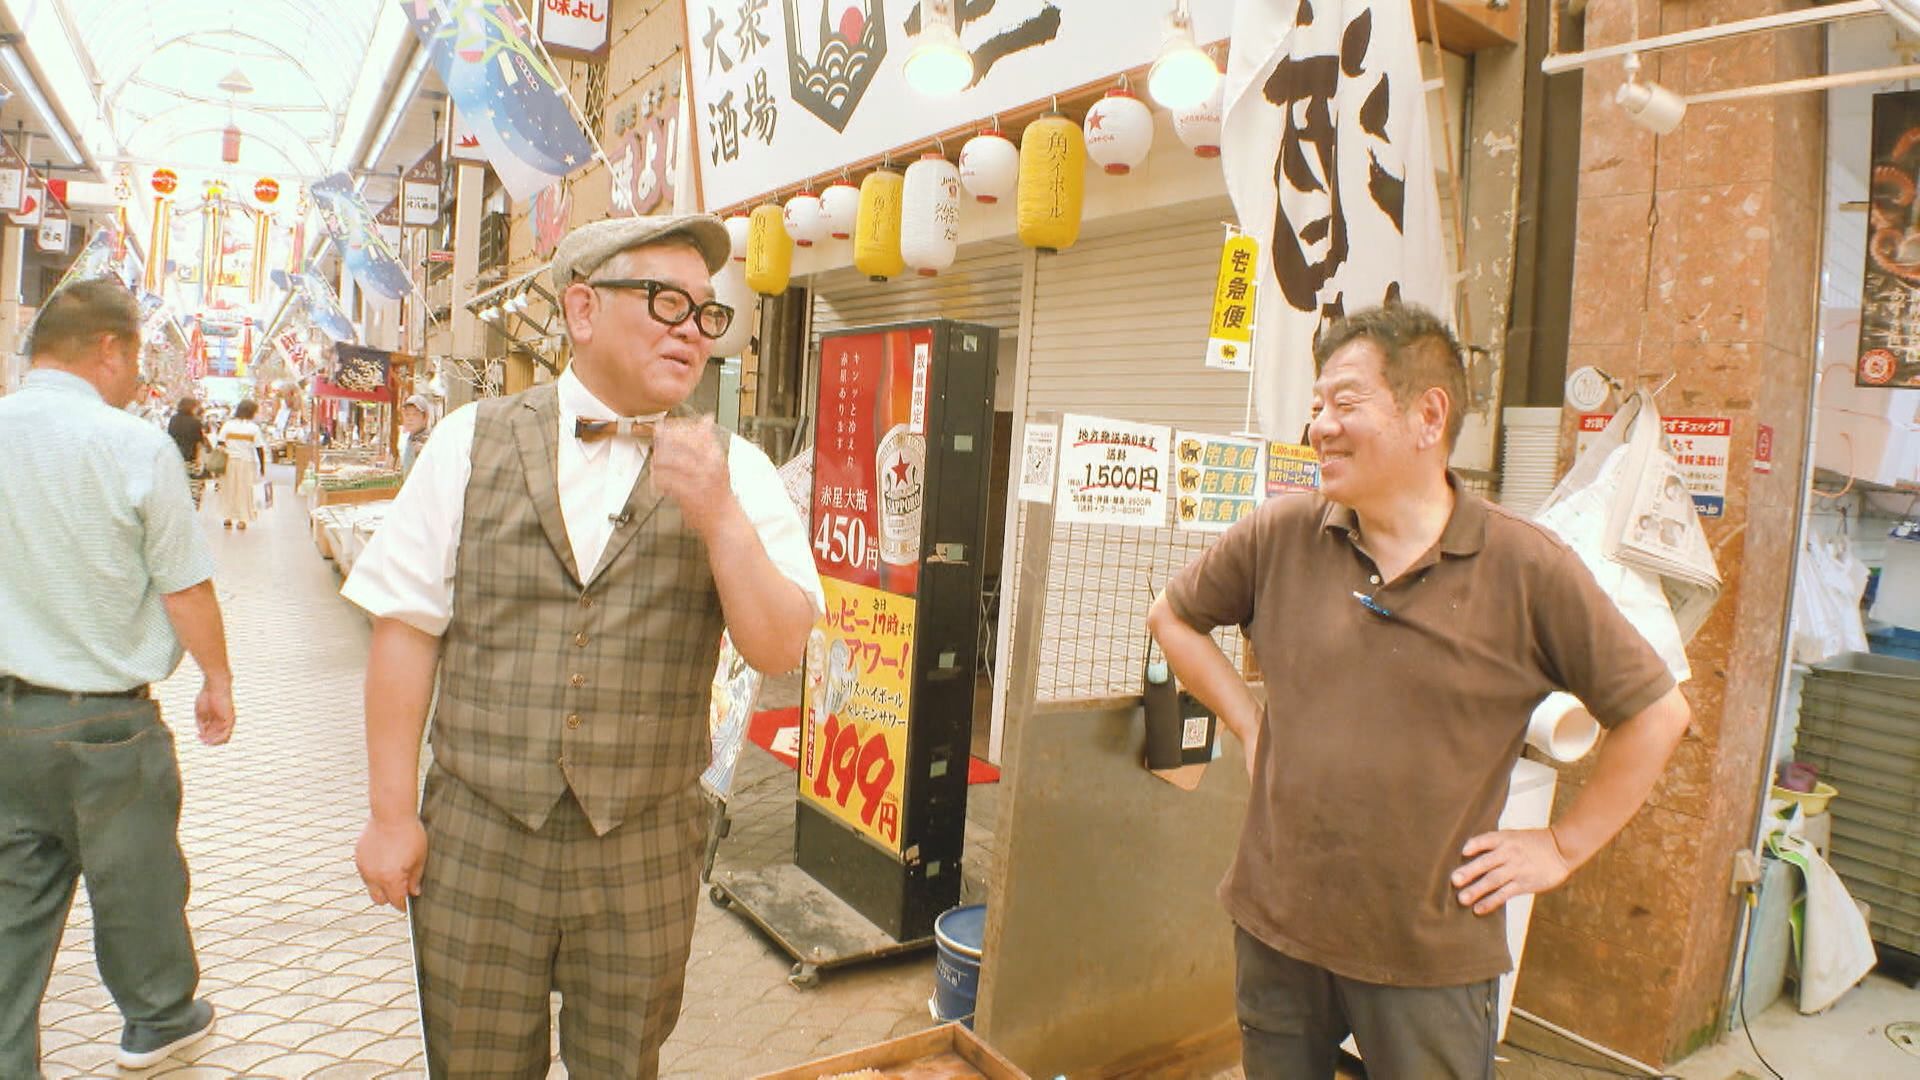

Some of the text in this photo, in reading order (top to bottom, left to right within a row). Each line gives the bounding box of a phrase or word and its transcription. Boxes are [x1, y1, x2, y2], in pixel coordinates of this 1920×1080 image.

[702, 0, 770, 78] 大衆
[708, 67, 777, 168] 酒場
[1047, 131, 1068, 219] 角ハイボール
[1223, 248, 1250, 329] 宅急便
[1077, 427, 1156, 448] 地方発送承ります
[1662, 420, 1725, 433] ずチェック!!
[1106, 447, 1127, 461] 送料
[1206, 443, 1257, 469] 宅急便
[1203, 471, 1256, 496] 宅急便
[820, 485, 869, 513] 赤星大瓶
[1201, 498, 1254, 521] 宅急便
[843, 639, 910, 681] アワー!
